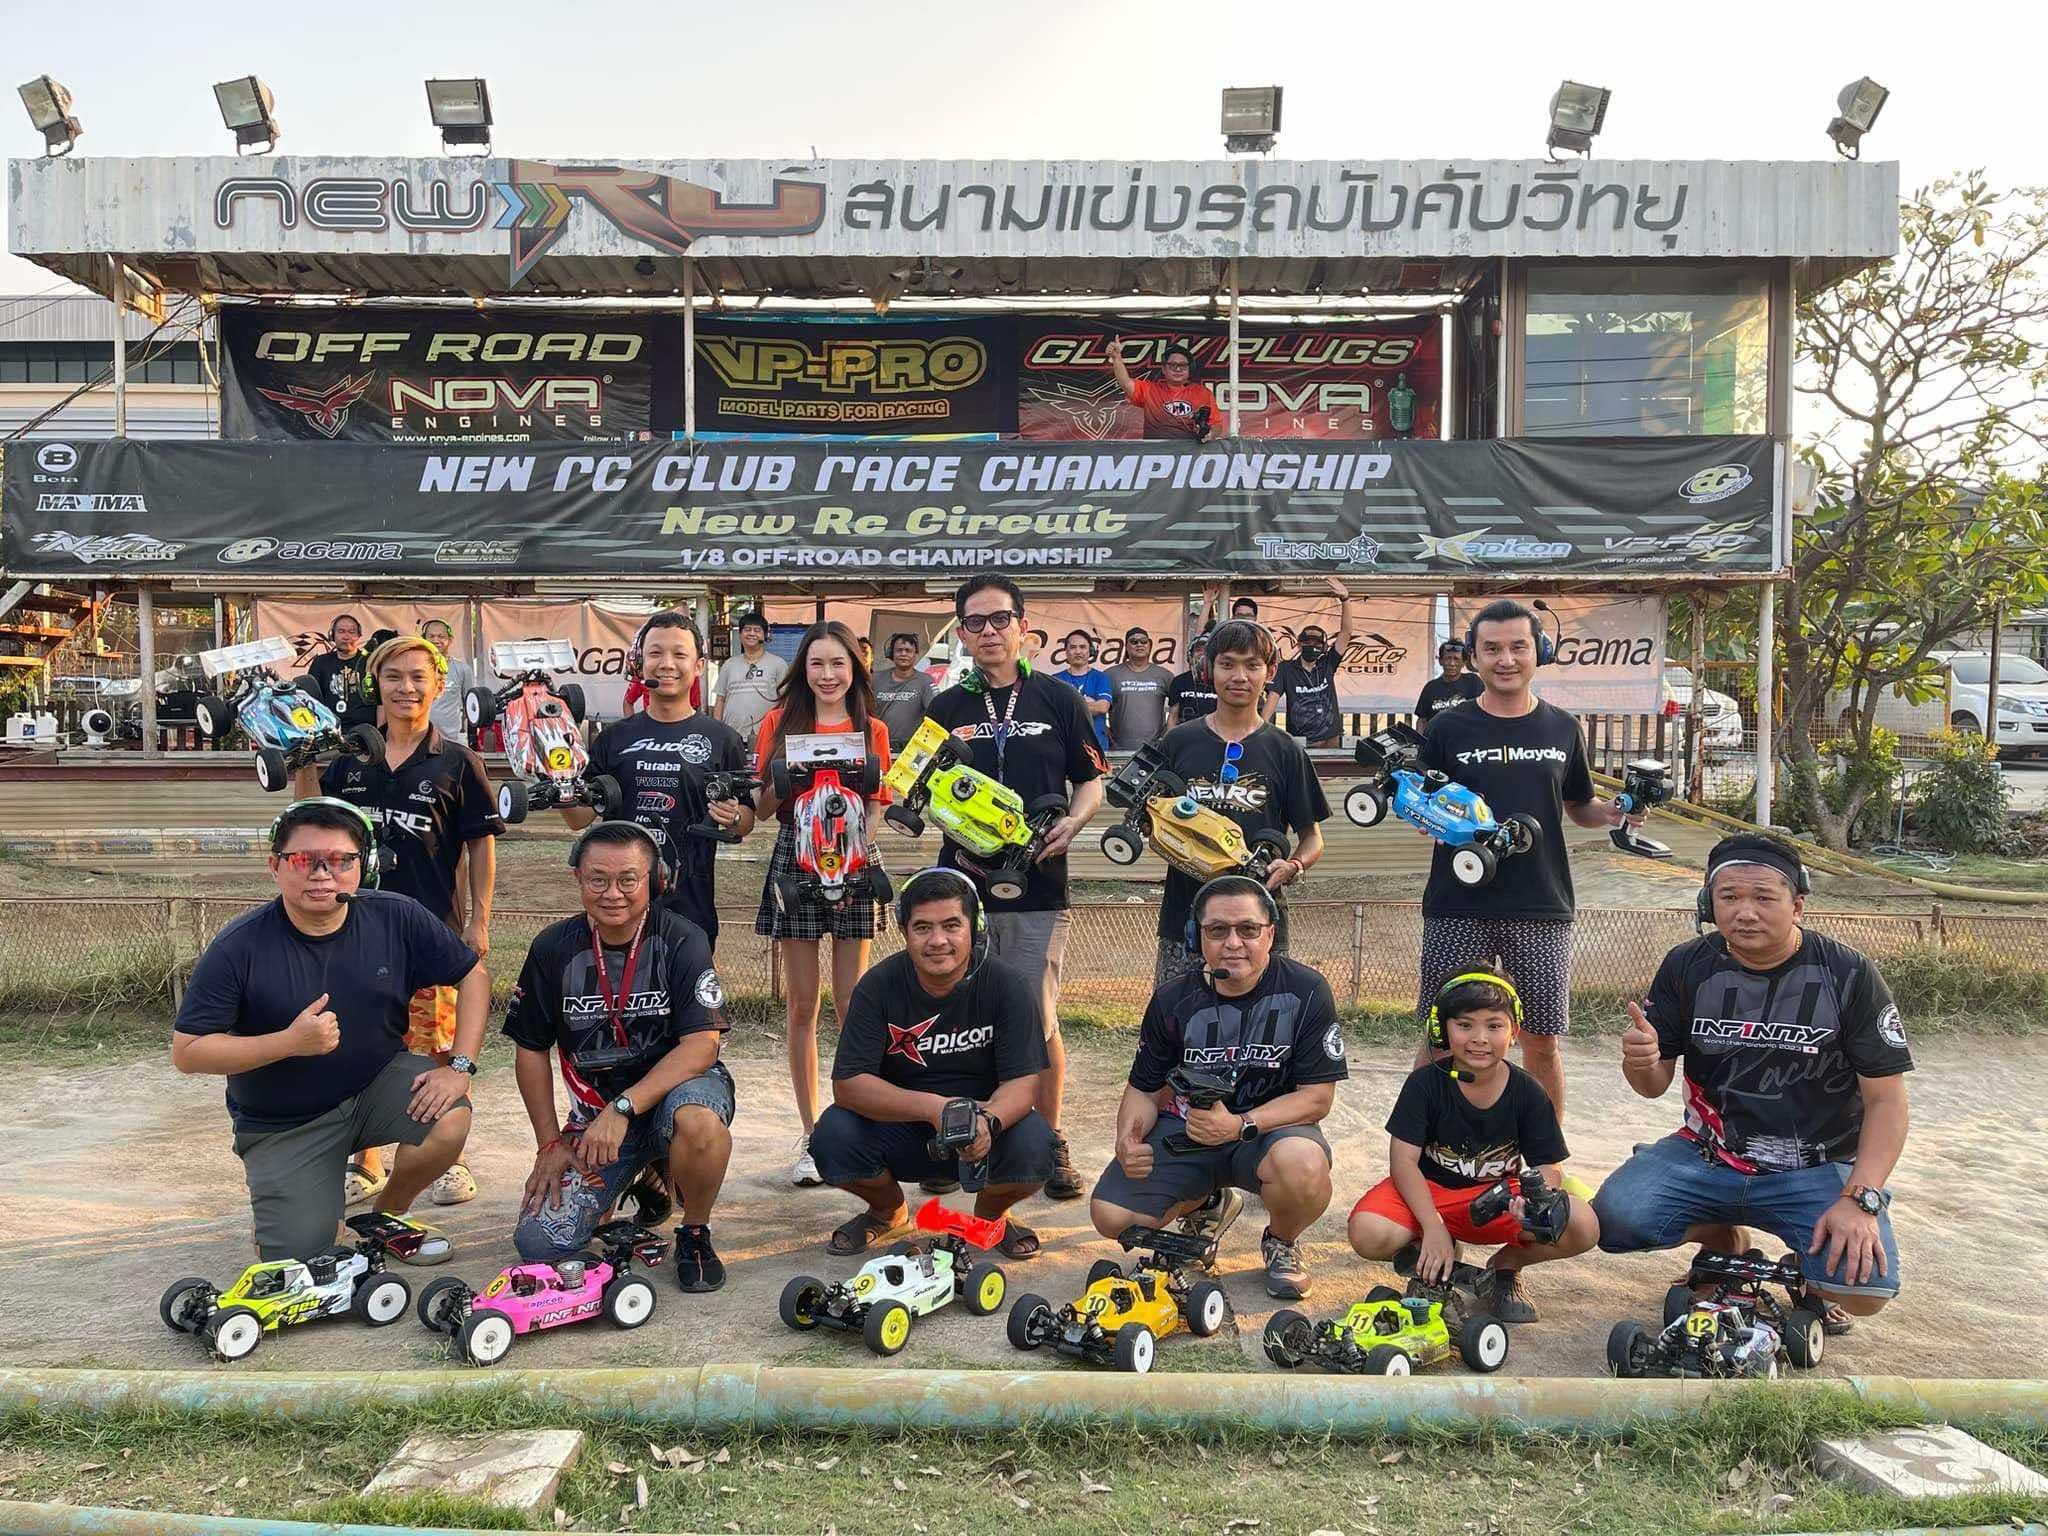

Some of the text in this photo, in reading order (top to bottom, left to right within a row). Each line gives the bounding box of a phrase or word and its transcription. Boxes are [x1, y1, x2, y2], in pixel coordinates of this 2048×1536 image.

[255, 331, 644, 363] OFF ROAD
[1215, 337, 1415, 365] PLUGS
[696, 336, 987, 392] VP-PRO
[389, 376, 602, 413] NOVA
[1206, 380, 1372, 413] OVA
[721, 400, 947, 418] MODEL PARTS FOR RACING
[391, 414, 602, 430] ENGINES
[33, 474, 79, 484] Beta
[418, 455, 535, 493] NEW
[651, 455, 797, 492] CLUB
[979, 453, 1394, 492] CHAMPIONSHIP
[660, 504, 1128, 536] New Rc Circuit
[680, 546, 1113, 571] 1/8 OFF-ROAD CHAMPIONSHIP
[1004, 690, 1019, 720] HUDY
[556, 753, 565, 765] 2
[1508, 747, 1567, 763] Mayako
[636, 761, 681, 772] Futaba
[1224, 835, 1234, 847] 5
[826, 857, 835, 867] 3
[1088, 1296, 1107, 1312] 10
[1351, 1314, 1371, 1330] 11
[1690, 1317, 1713, 1333] 12
